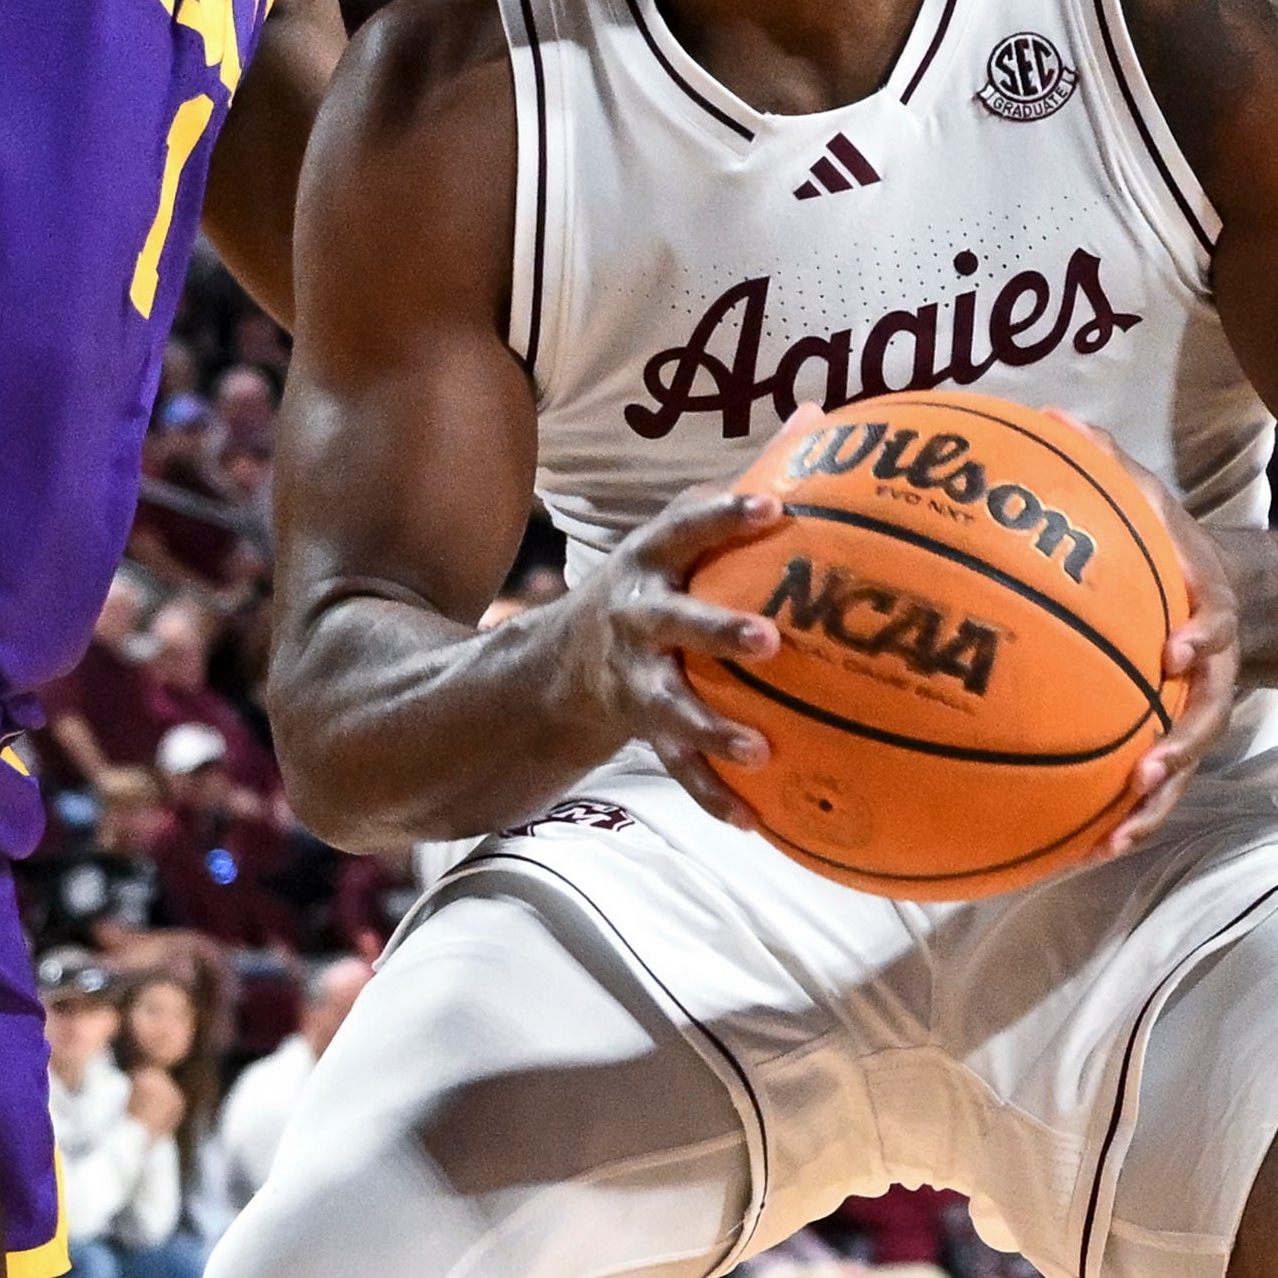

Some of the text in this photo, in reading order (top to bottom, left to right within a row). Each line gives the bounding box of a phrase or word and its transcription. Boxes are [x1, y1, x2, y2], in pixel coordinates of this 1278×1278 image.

[992, 87, 1069, 119] GRADUATE
[994, 38, 1056, 97] SEC
[787, 422, 1097, 585] Wilson
[761, 554, 999, 697] NCAA
